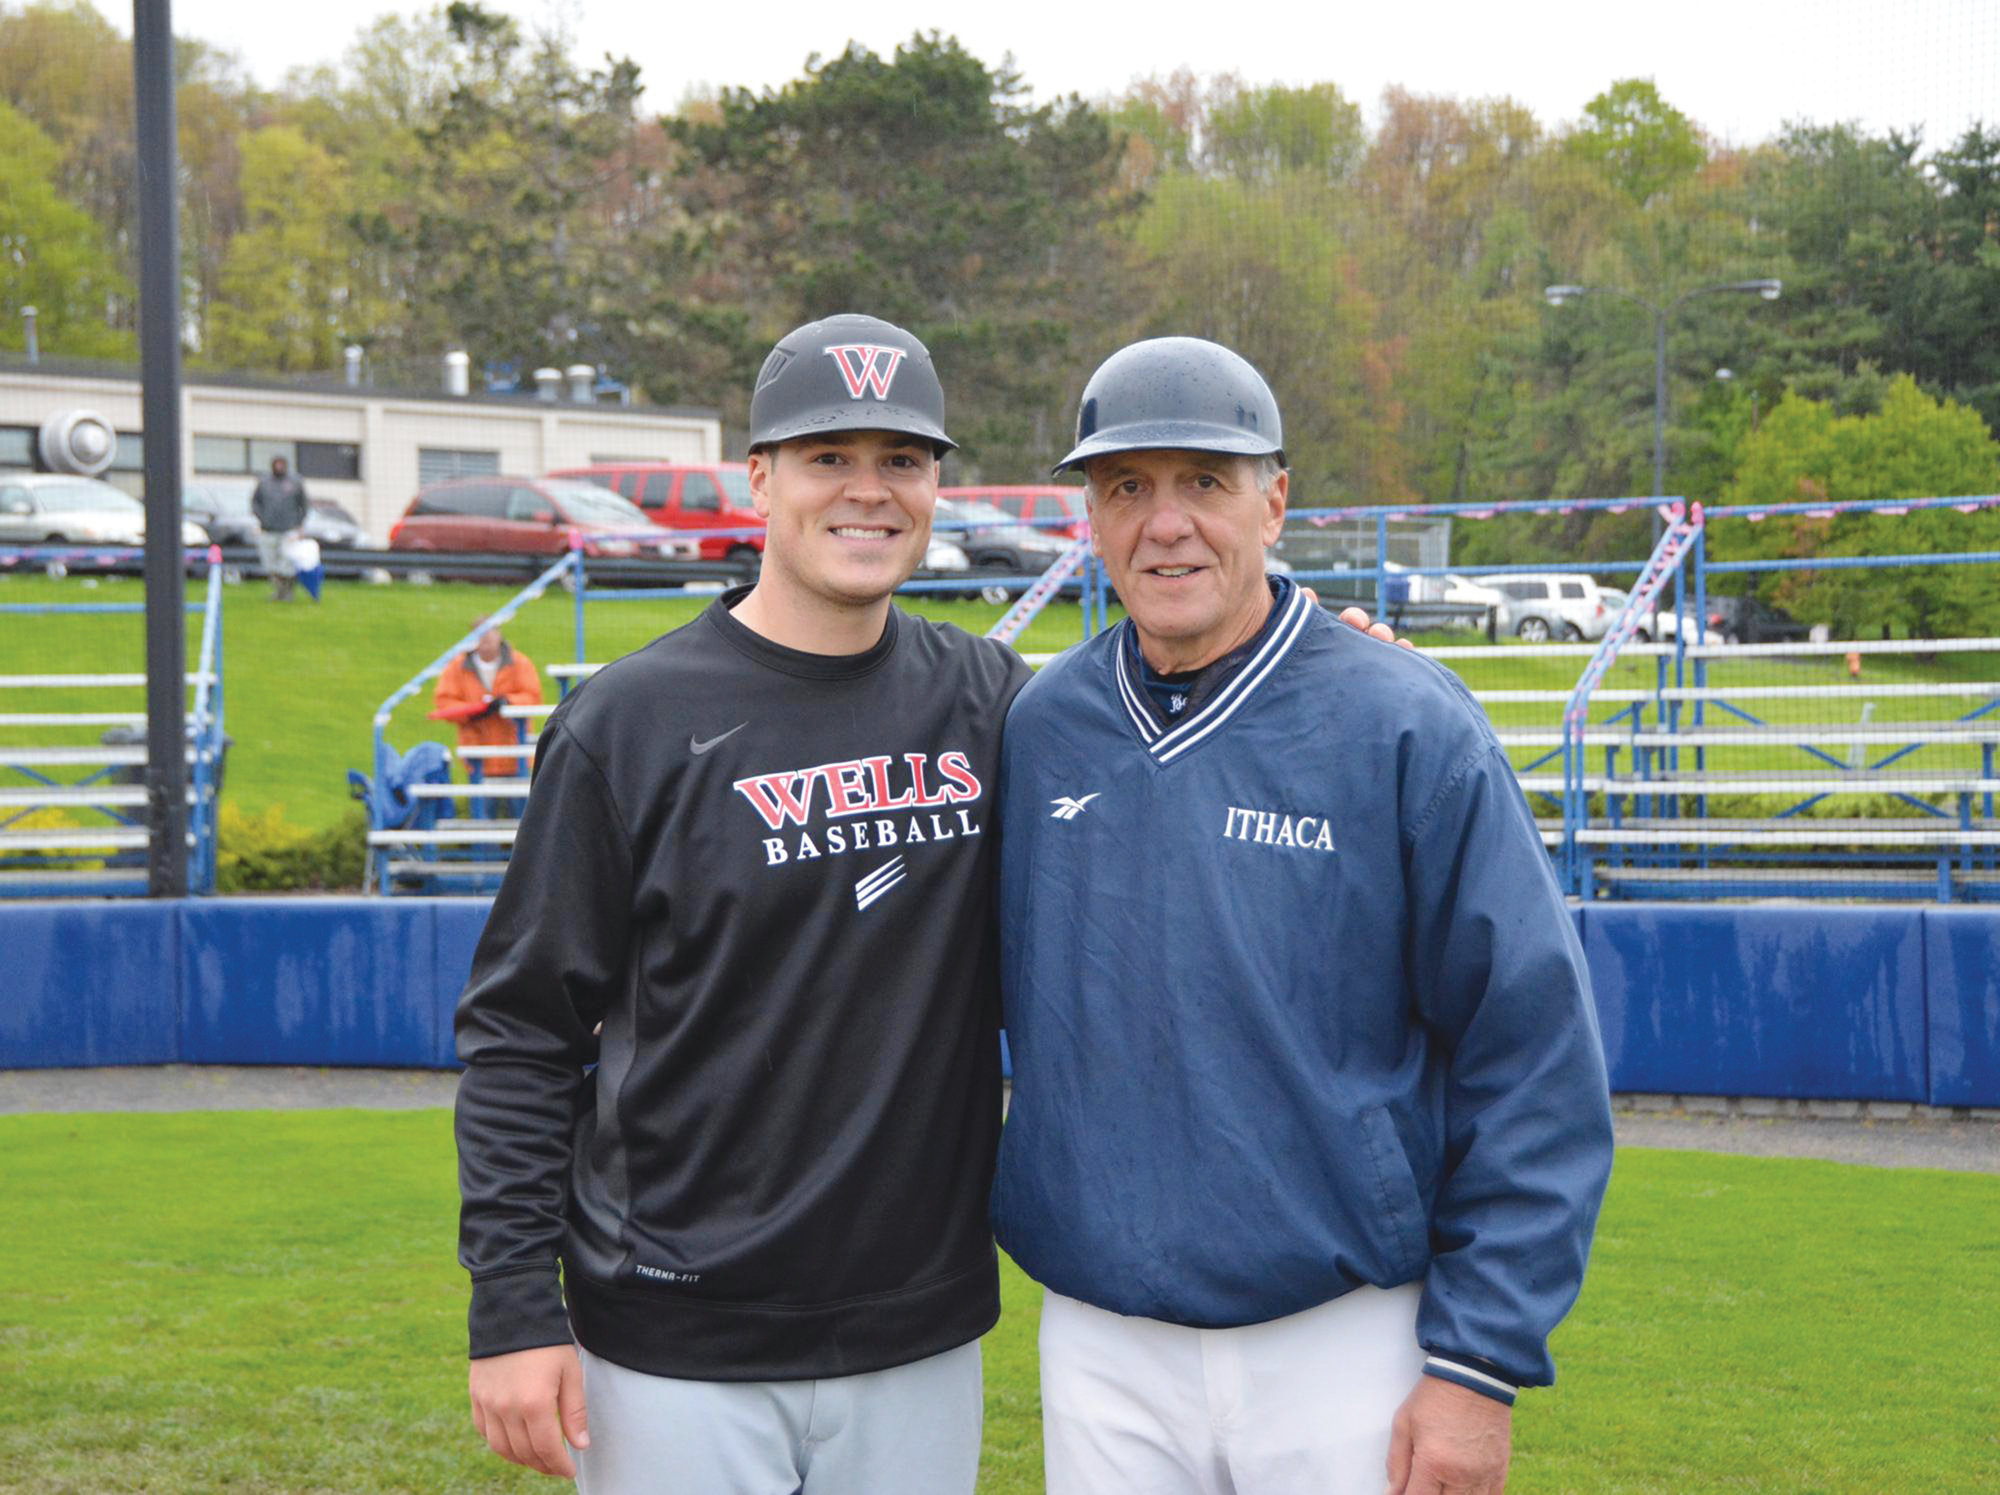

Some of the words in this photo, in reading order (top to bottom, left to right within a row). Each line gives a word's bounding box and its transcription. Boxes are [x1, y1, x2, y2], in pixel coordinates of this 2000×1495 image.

[824, 344, 907, 401] W
[733, 751, 982, 831] WELLS
[762, 809, 981, 866] BASEBALL
[1223, 806, 1335, 851] ITHACA
[635, 1264, 700, 1283] THERMA-FIT
